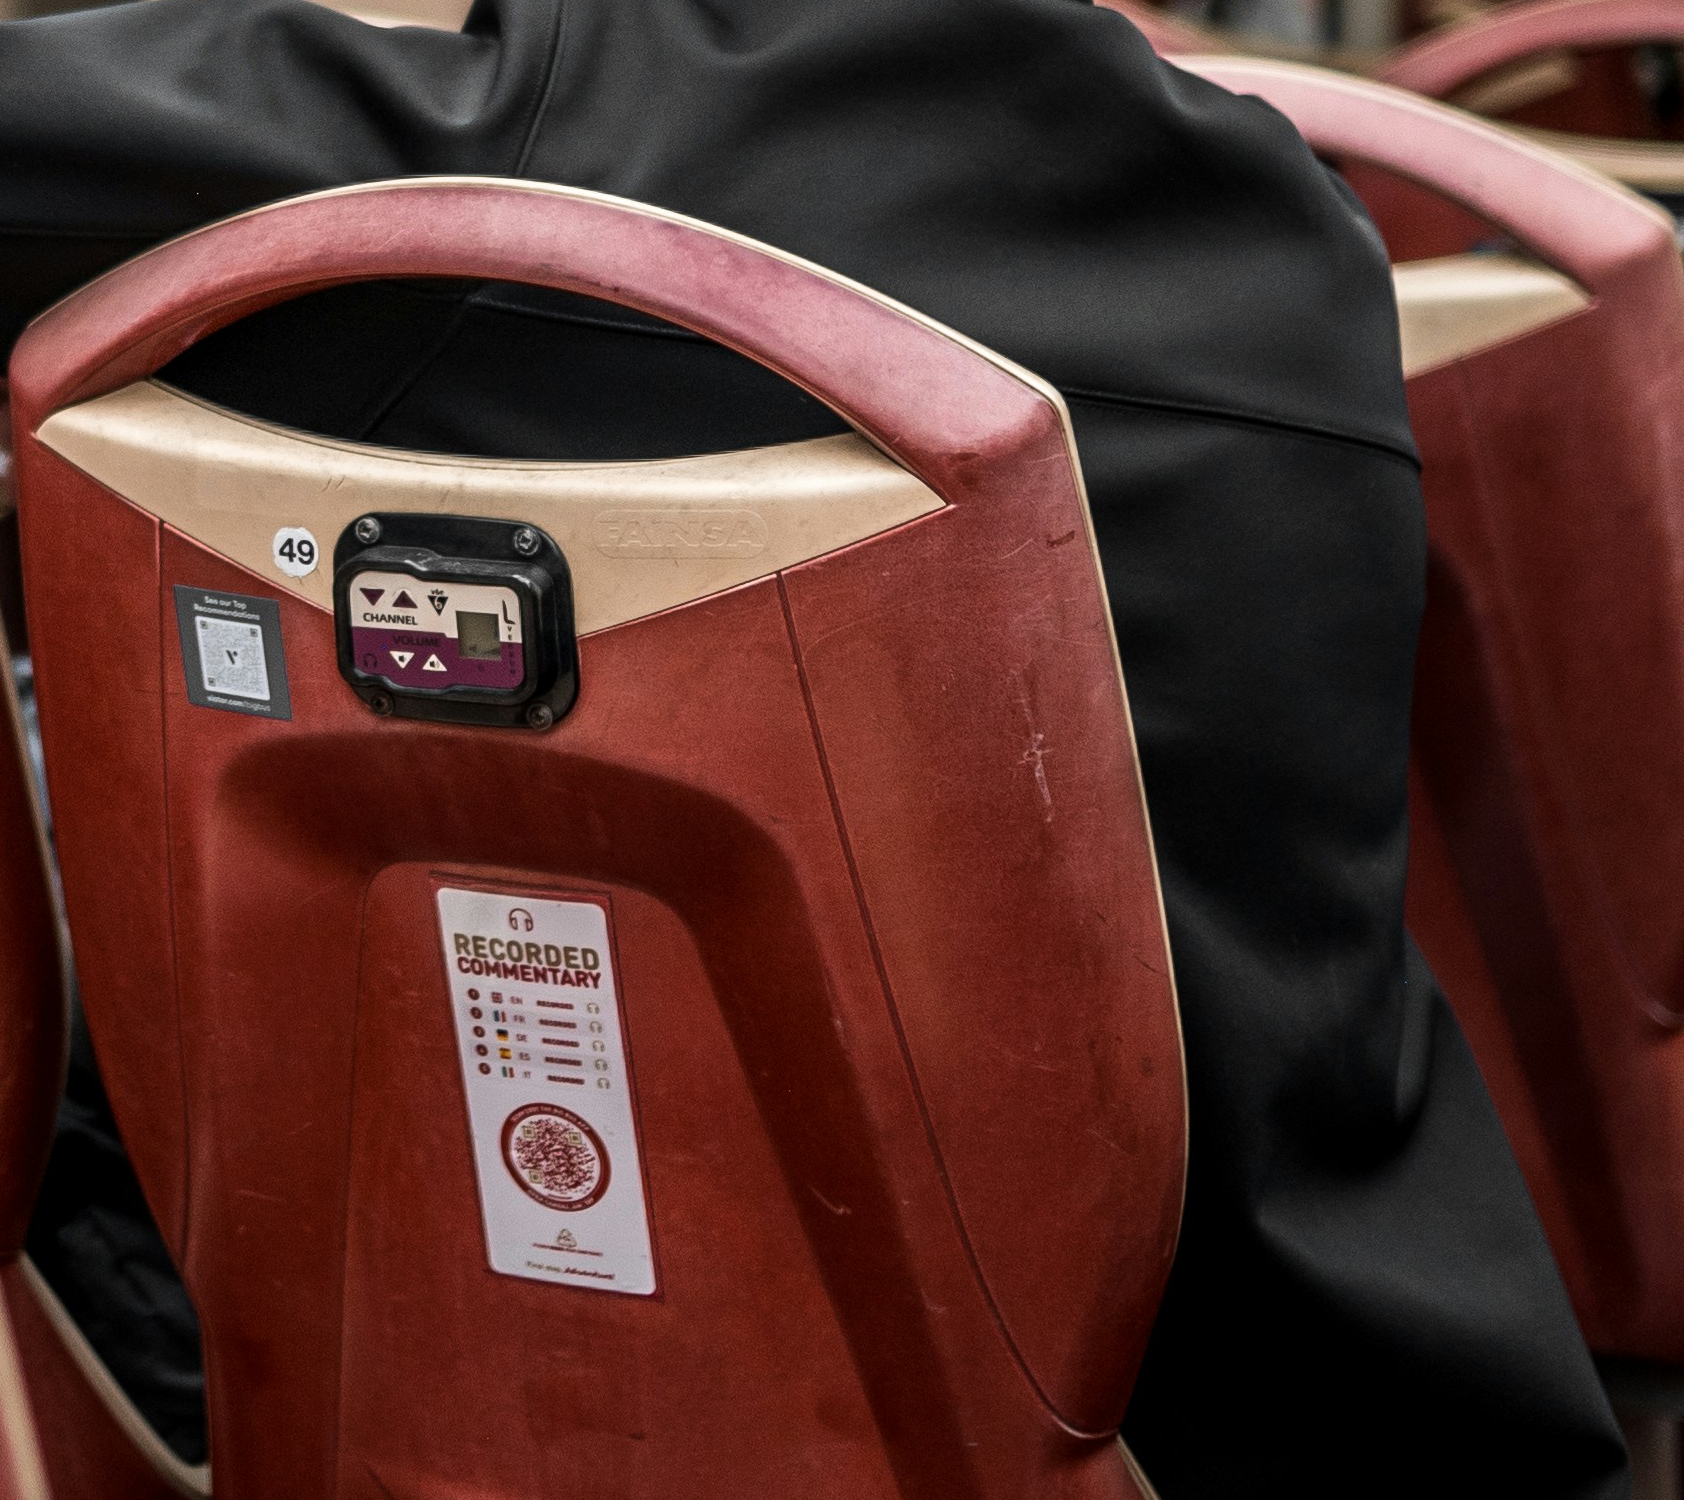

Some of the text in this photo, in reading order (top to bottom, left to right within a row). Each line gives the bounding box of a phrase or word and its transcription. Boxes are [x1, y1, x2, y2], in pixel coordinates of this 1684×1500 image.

[278, 538, 315, 565] 49
[363, 613, 419, 626] CHANNEL
[392, 635, 442, 648] VOLUME
[454, 933, 600, 971] RECORDED
[457, 956, 602, 990] COMMENTARY
